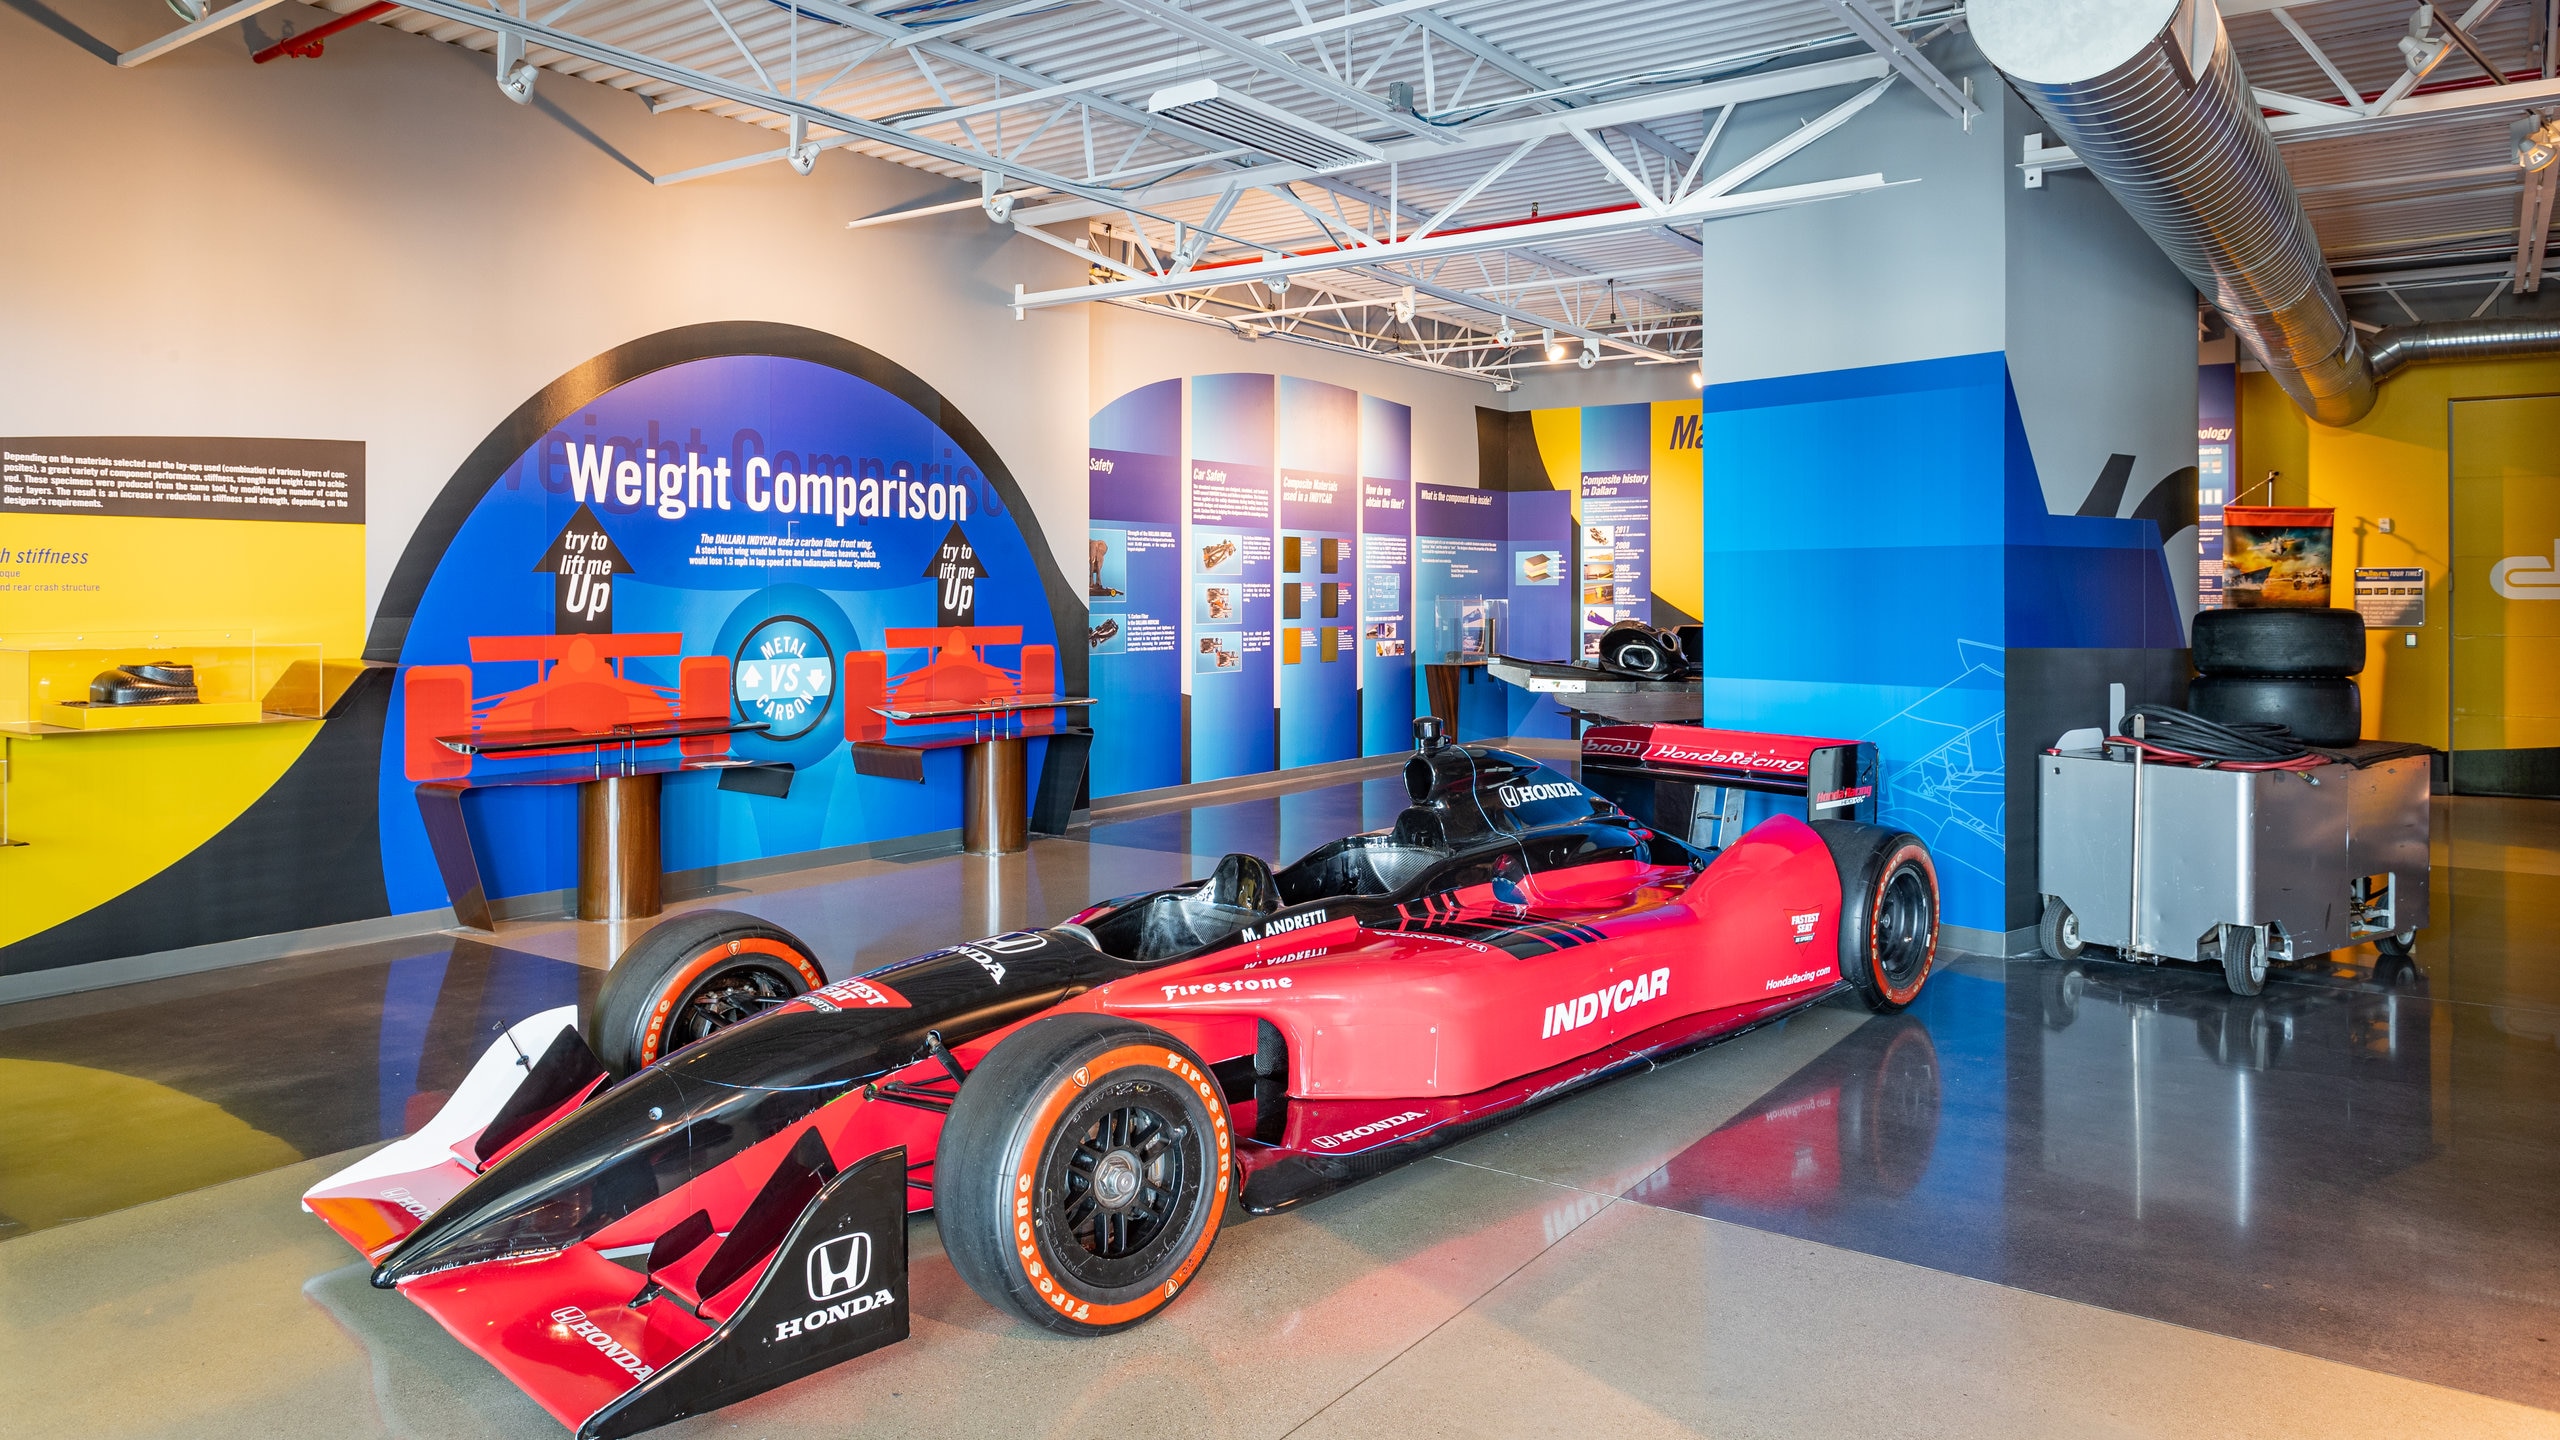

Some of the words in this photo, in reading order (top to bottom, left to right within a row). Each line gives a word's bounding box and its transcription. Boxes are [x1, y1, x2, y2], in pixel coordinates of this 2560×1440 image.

[3, 451, 47, 463] Depending
[48, 455, 59, 463] on
[60, 454, 73, 463] the
[74, 455, 112, 466] materials
[113, 457, 146, 468] selected
[146, 459, 161, 468] and
[162, 460, 174, 469] the
[175, 461, 202, 472] lay-ups
[203, 462, 221, 472] used
[221, 463, 267, 474] (combination
[267, 466, 275, 475] of
[276, 467, 301, 476] various
[301, 468, 322, 478] layers
[322, 469, 330, 477] of
[3, 462, 39, 474] posites),
[40, 465, 46, 473] a
[47, 465, 69, 475] great
[70, 466, 98, 477] variety
[99, 467, 108, 476] of
[109, 468, 151, 479] component
[152, 470, 202, 481] performance,
[203, 472, 235, 483] stiffness,
[236, 475, 266, 485] strength
[267, 476, 280, 485] and
[280, 477, 303, 487] weight
[317, 479, 326, 487] be
[326, 479, 347, 488] achie-
[1089, 457, 1114, 475] Safety
[1193, 468, 1206, 480] Car
[1206, 469, 1227, 485] Safety
[566, 441, 731, 520] Weight
[746, 456, 967, 527] Comparison
[1283, 476, 1313, 491] Composite
[1313, 479, 1338, 492] Materials
[1366, 484, 1377, 495] How
[1377, 485, 1384, 496] do
[1384, 487, 1392, 497] we
[1582, 474, 1621, 486] Composite
[1622, 473, 1649, 485] history
[1582, 487, 1590, 496] in
[1590, 486, 1618, 496] Dallara
[3, 495, 46, 507] designer's
[47, 497, 103, 508] requirements.
[1421, 489, 1433, 501] What
[1438, 491, 1446, 502] the
[1446, 494, 1470, 505] component
[1470, 494, 1478, 505] like
[1478, 495, 1493, 506] inside?
[565, 530, 590, 554] try
[590, 531, 608, 551] to
[695, 545, 700, 554] A
[701, 545, 717, 555] steel
[718, 546, 734, 555] front
[734, 546, 749, 557] wing
[750, 547, 768, 556] would
[768, 547, 776, 556] be
[777, 547, 793, 557] three
[793, 549, 805, 557] and
[810, 548, 821, 557] half
[822, 548, 838, 558] times
[838, 549, 860, 559] heavier,
[860, 550, 876, 559] which
[701, 533, 714, 544] The
[715, 533, 746, 545] DALLARA
[747, 534, 778, 546] INDYCAR
[778, 538, 794, 547] uses
[794, 539, 800, 547] a
[800, 537, 824, 548] carbon
[824, 537, 840, 548] fiber
[840, 538, 857, 549] front
[856, 540, 873, 551] wing.
[942, 543, 959, 562] try
[961, 544, 973, 560] to
[16, 548, 89, 564] stiffness
[560, 554, 585, 575] lift
[585, 559, 612, 575] me
[689, 556, 709, 565] would
[709, 556, 723, 566] lose
[724, 556, 734, 566] 1.5
[734, 556, 748, 567] mph
[748, 557, 755, 566] in
[755, 557, 766, 567] lap
[766, 558, 784, 568] speed
[784, 558, 792, 567] at
[792, 559, 802, 567] the
[802, 559, 837, 569] Indianapolis
[837, 559, 853, 568] Motor
[853, 560, 881, 570] Speedway.
[939, 562, 956, 579] lift
[958, 566, 975, 580] me
[13, 584, 32, 592] rear
[34, 583, 59, 592] crash
[61, 583, 101, 592] structure
[566, 573, 610, 621] Up
[944, 577, 973, 617] Up
[760, 635, 807, 661] METAL
[770, 662, 801, 693] VS
[756, 689, 815, 721] CARBON
[1516, 782, 1583, 803] HONDA
[1241, 927, 1261, 943] M.
[1265, 909, 1328, 938] ANDRETTI
[1791, 912, 1820, 926] FASTEST
[1796, 923, 1814, 934] SEAT
[955, 944, 1006, 985] NDA
[834, 978, 889, 1006] STEST
[1160, 976, 1293, 1001] Firestone
[1542, 967, 1670, 1040] INDYCAR
[1166, 1052, 1230, 1194] Firestone
[1332, 1110, 1427, 1143] HONDA
[394, 1195, 435, 1222] HON
[1017, 1172, 1090, 1321] Firestone
[775, 1288, 895, 1341] HONDA
[569, 1319, 655, 1383] HONDA
